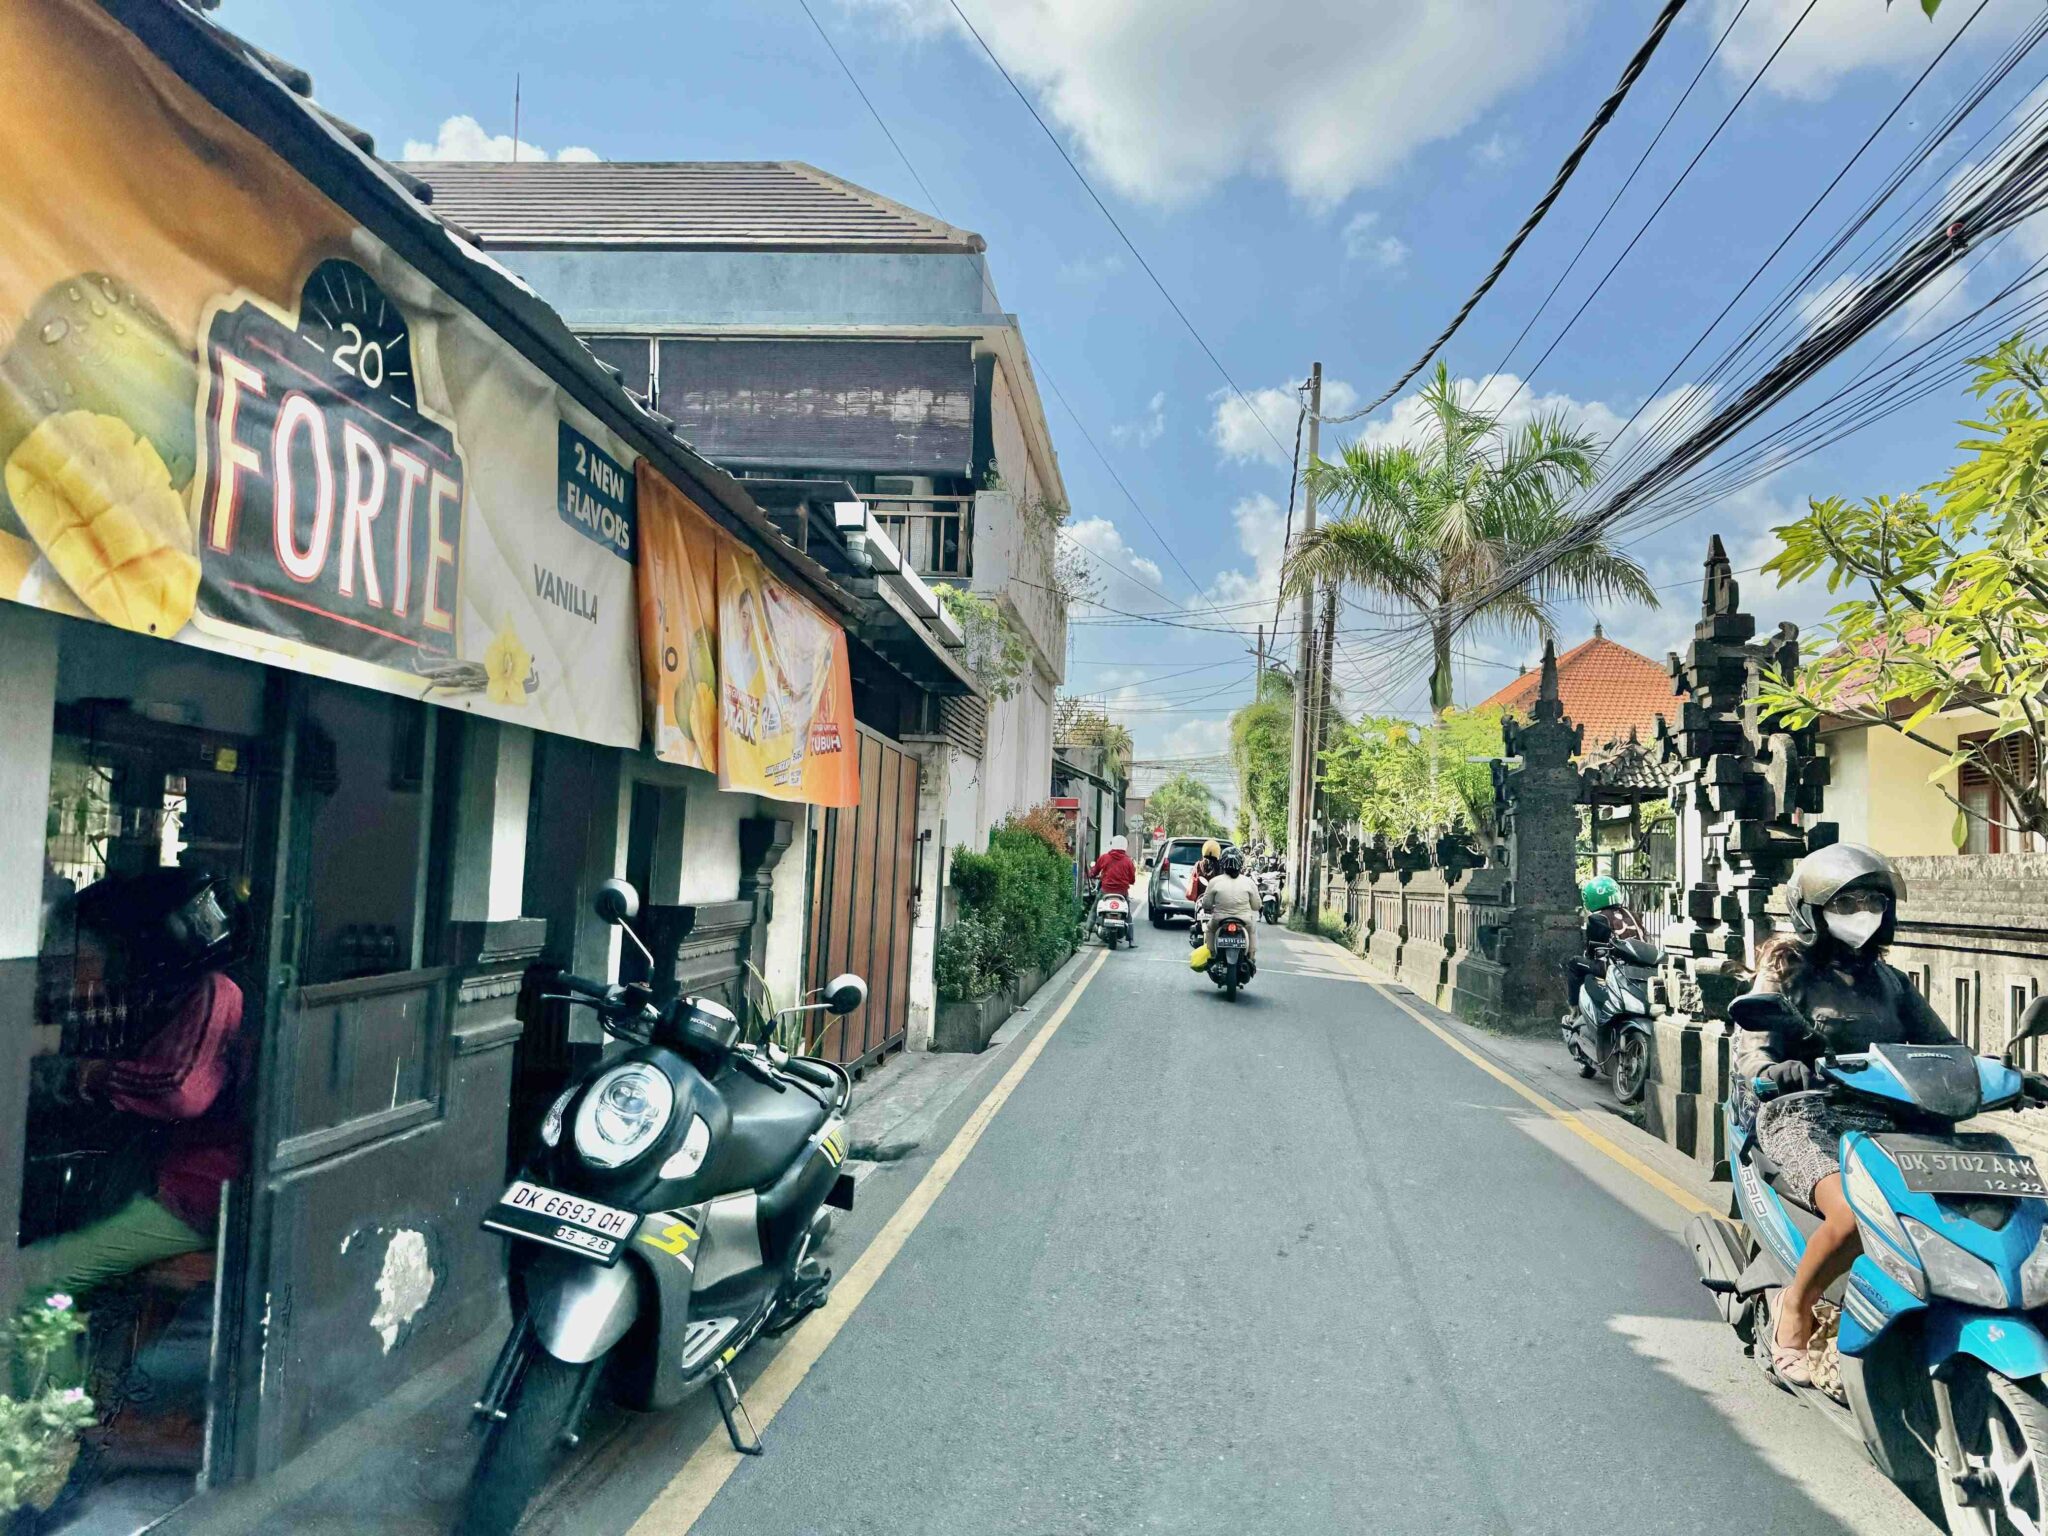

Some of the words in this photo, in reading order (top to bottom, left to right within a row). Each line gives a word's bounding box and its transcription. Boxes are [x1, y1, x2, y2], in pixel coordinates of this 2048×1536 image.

[331, 322, 383, 388] 20
[208, 346, 460, 632] FORTE
[575, 443, 586, 476] 2
[590, 454, 625, 503] NEW
[566, 481, 630, 550] FLAVORS
[534, 564, 598, 624] VANILLA
[690, 1017, 718, 1032] HONDA
[1906, 1052, 1953, 1060] HONDA
[1741, 1165, 1767, 1217] ARIO
[1901, 1154, 1928, 1171] DK
[1932, 1155, 1988, 1173] 5702
[1993, 1157, 2037, 1177] AAK
[513, 1188, 543, 1208] DK
[544, 1197, 596, 1224] 6693
[597, 1212, 627, 1234] QH
